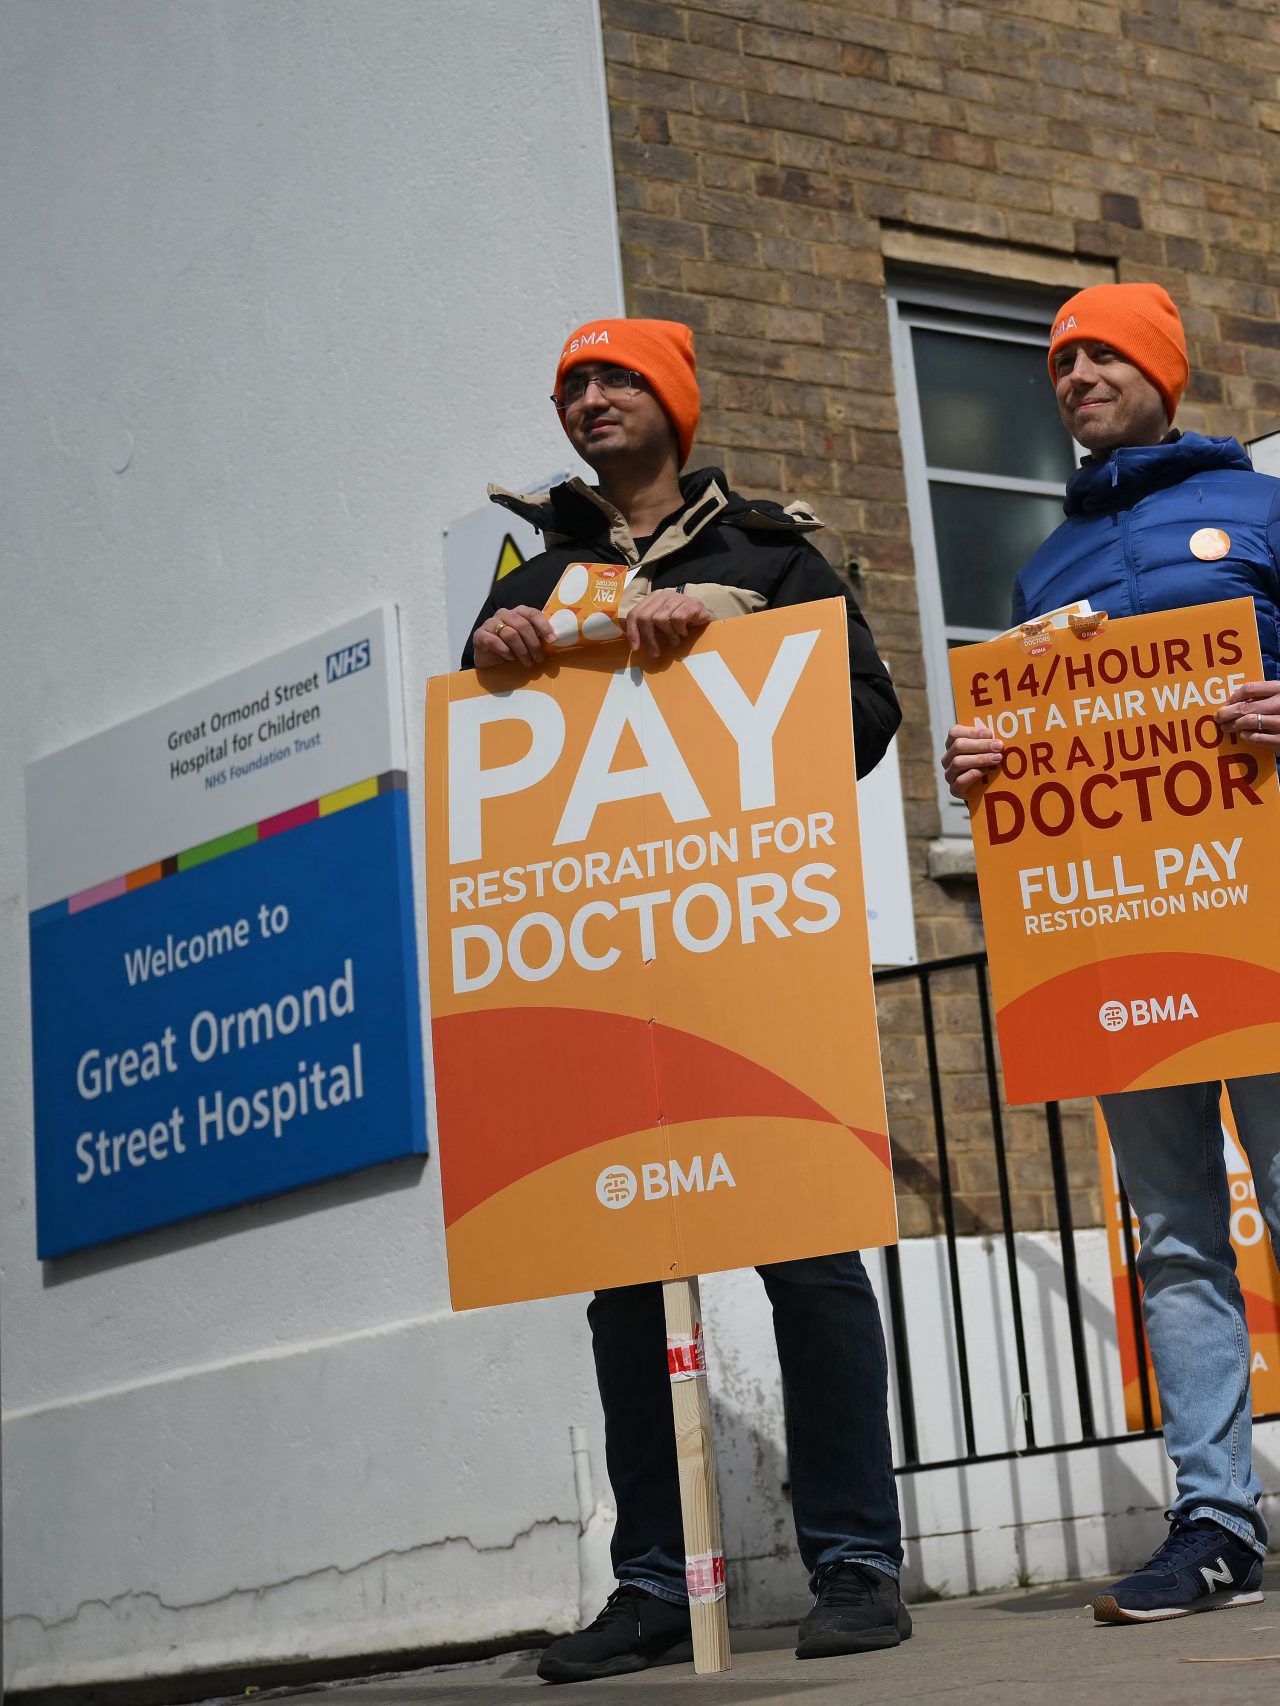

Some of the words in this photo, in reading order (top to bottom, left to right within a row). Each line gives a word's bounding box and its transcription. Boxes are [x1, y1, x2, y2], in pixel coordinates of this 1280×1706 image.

[570, 330, 609, 353] BMA
[327, 641, 370, 683] NHS
[969, 637, 1194, 708] £14/HOUR
[1203, 629, 1244, 669] IS
[1024, 635, 1051, 647] DOCTORS
[168, 721, 207, 751] Great
[210, 691, 270, 733] Ormond
[274, 672, 319, 706] Street
[1044, 703, 1068, 732] A
[1073, 689, 1146, 726] FAIR
[1151, 672, 1246, 713] WAGE
[170, 739, 228, 780] Hospital
[233, 733, 254, 754] for
[257, 704, 321, 743] Children
[204, 771, 227, 792] NHS
[229, 745, 292, 781] Foundation
[293, 732, 321, 754] Trust
[449, 628, 822, 865] PAY
[981, 741, 1056, 785] OR
[1066, 735, 1096, 771] A
[1101, 713, 1239, 772] JUNIO
[983, 752, 1264, 846] DOCTOR
[449, 827, 738, 913] RESTORATION
[750, 811, 836, 860] FOR
[1018, 855, 1145, 909] FULL
[1154, 837, 1244, 889] PAY
[124, 917, 250, 987] Welcome
[258, 903, 289, 939] to
[450, 862, 841, 994] DOCTORS
[1025, 897, 1186, 935] RESTORATION
[1193, 884, 1249, 911] NOW
[76, 1025, 178, 1101] Great
[189, 957, 355, 1063] Ormond
[1130, 993, 1200, 1026] BMA
[76, 1106, 186, 1185] Street
[198, 1042, 364, 1146] Hospital
[641, 1152, 737, 1201] BMA
